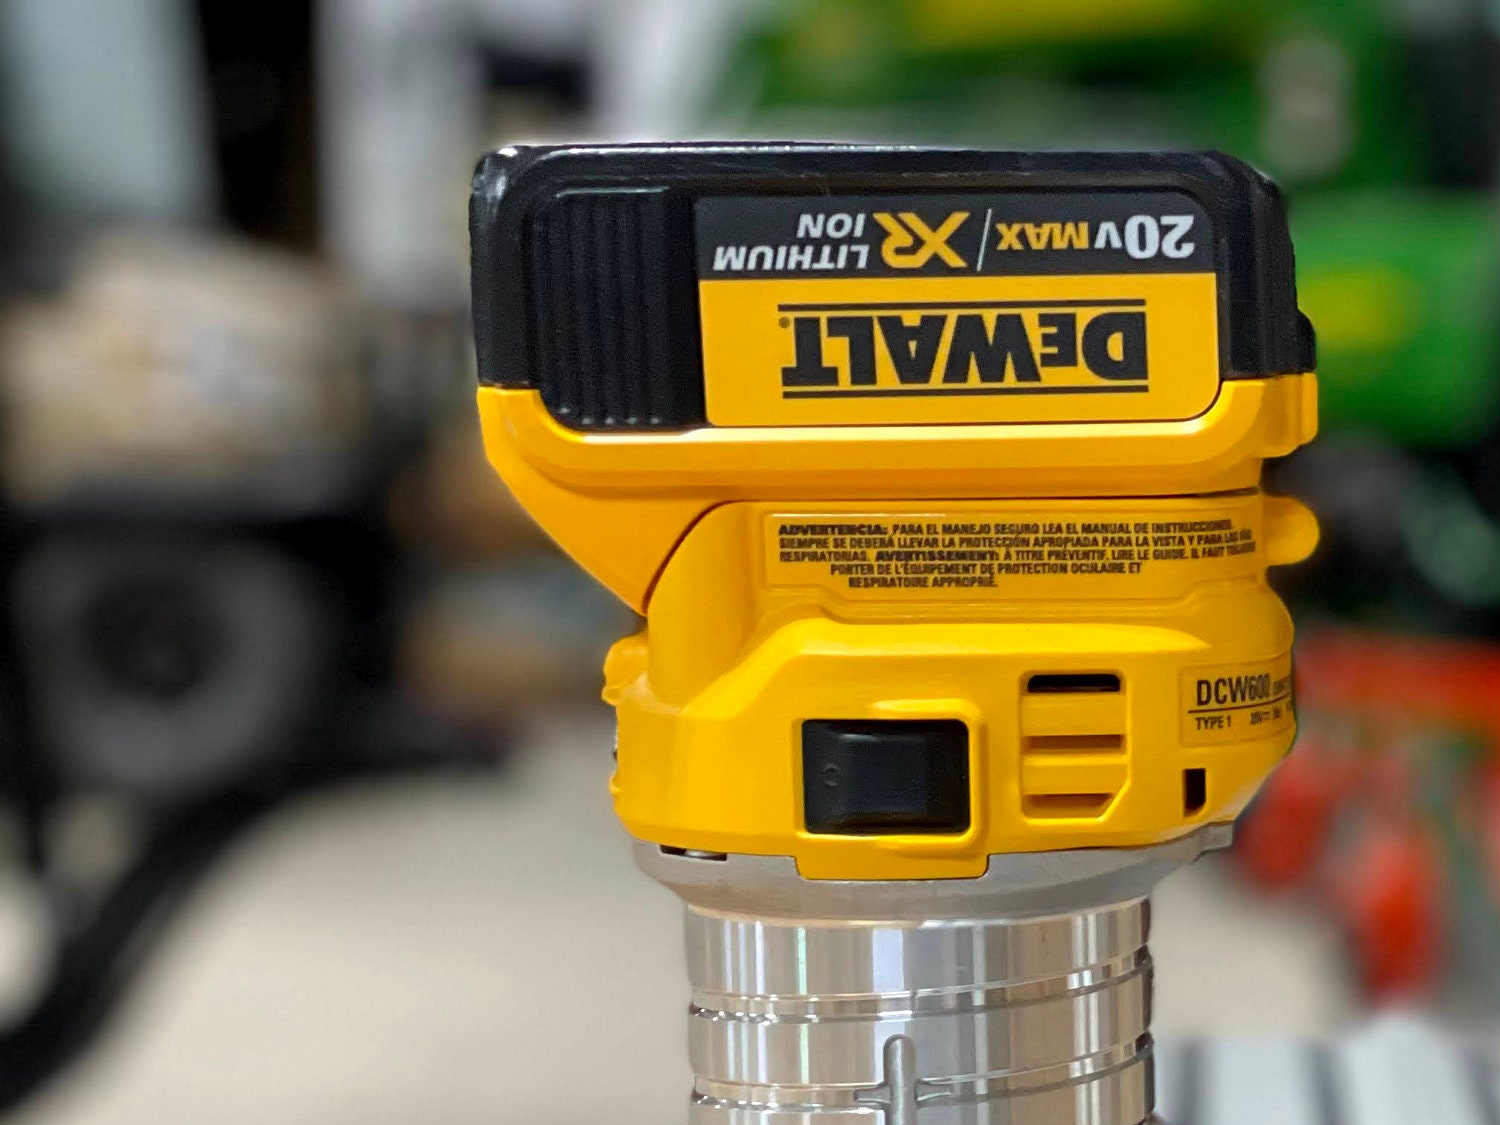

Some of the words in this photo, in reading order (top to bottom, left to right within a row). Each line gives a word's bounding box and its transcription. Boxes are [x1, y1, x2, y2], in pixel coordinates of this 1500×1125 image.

[796, 212, 867, 240] ION
[872, 210, 971, 270] XR
[996, 221, 1090, 252] MAX
[712, 243, 870, 272] LITHIUM
[781, 310, 1150, 388] DEWALT
[892, 523, 924, 536] PARA
[926, 523, 939, 535] EL
[942, 523, 991, 535] MANEJO
[994, 523, 1040, 536] SEGURO
[1043, 523, 1063, 535] LEA
[1066, 523, 1079, 535] EL
[1081, 522, 1131, 534] MANUAL
[1134, 522, 1149, 534] DE
[780, 537, 830, 549] SIEMPRE
[833, 537, 847, 549] SE
[898, 537, 939, 549] LLEVAR
[942, 537, 956, 548] LA
[1033, 536, 1099, 548] APROPIADA
[1101, 536, 1133, 547] PARA
[1135, 536, 1149, 547] LA
[1152, 535, 1186, 547] VISTA
[1187, 535, 1196, 545] Y
[1014, 550, 1045, 561] TITRE
[1112, 549, 1135, 560] LIRE
[1138, 549, 1150, 560] LE
[831, 564, 874, 575] PORTER
[877, 564, 892, 575] DE
[980, 563, 995, 574] DE
[997, 563, 1068, 574] PROTECTION
[1071, 562, 1126, 574] OCULAIRE
[1128, 562, 1142, 573] ET
[848, 577, 929, 588] RESPIRATOIRE
[1194, 715, 1224, 730] TYPE
[1226, 714, 1232, 728] 1
